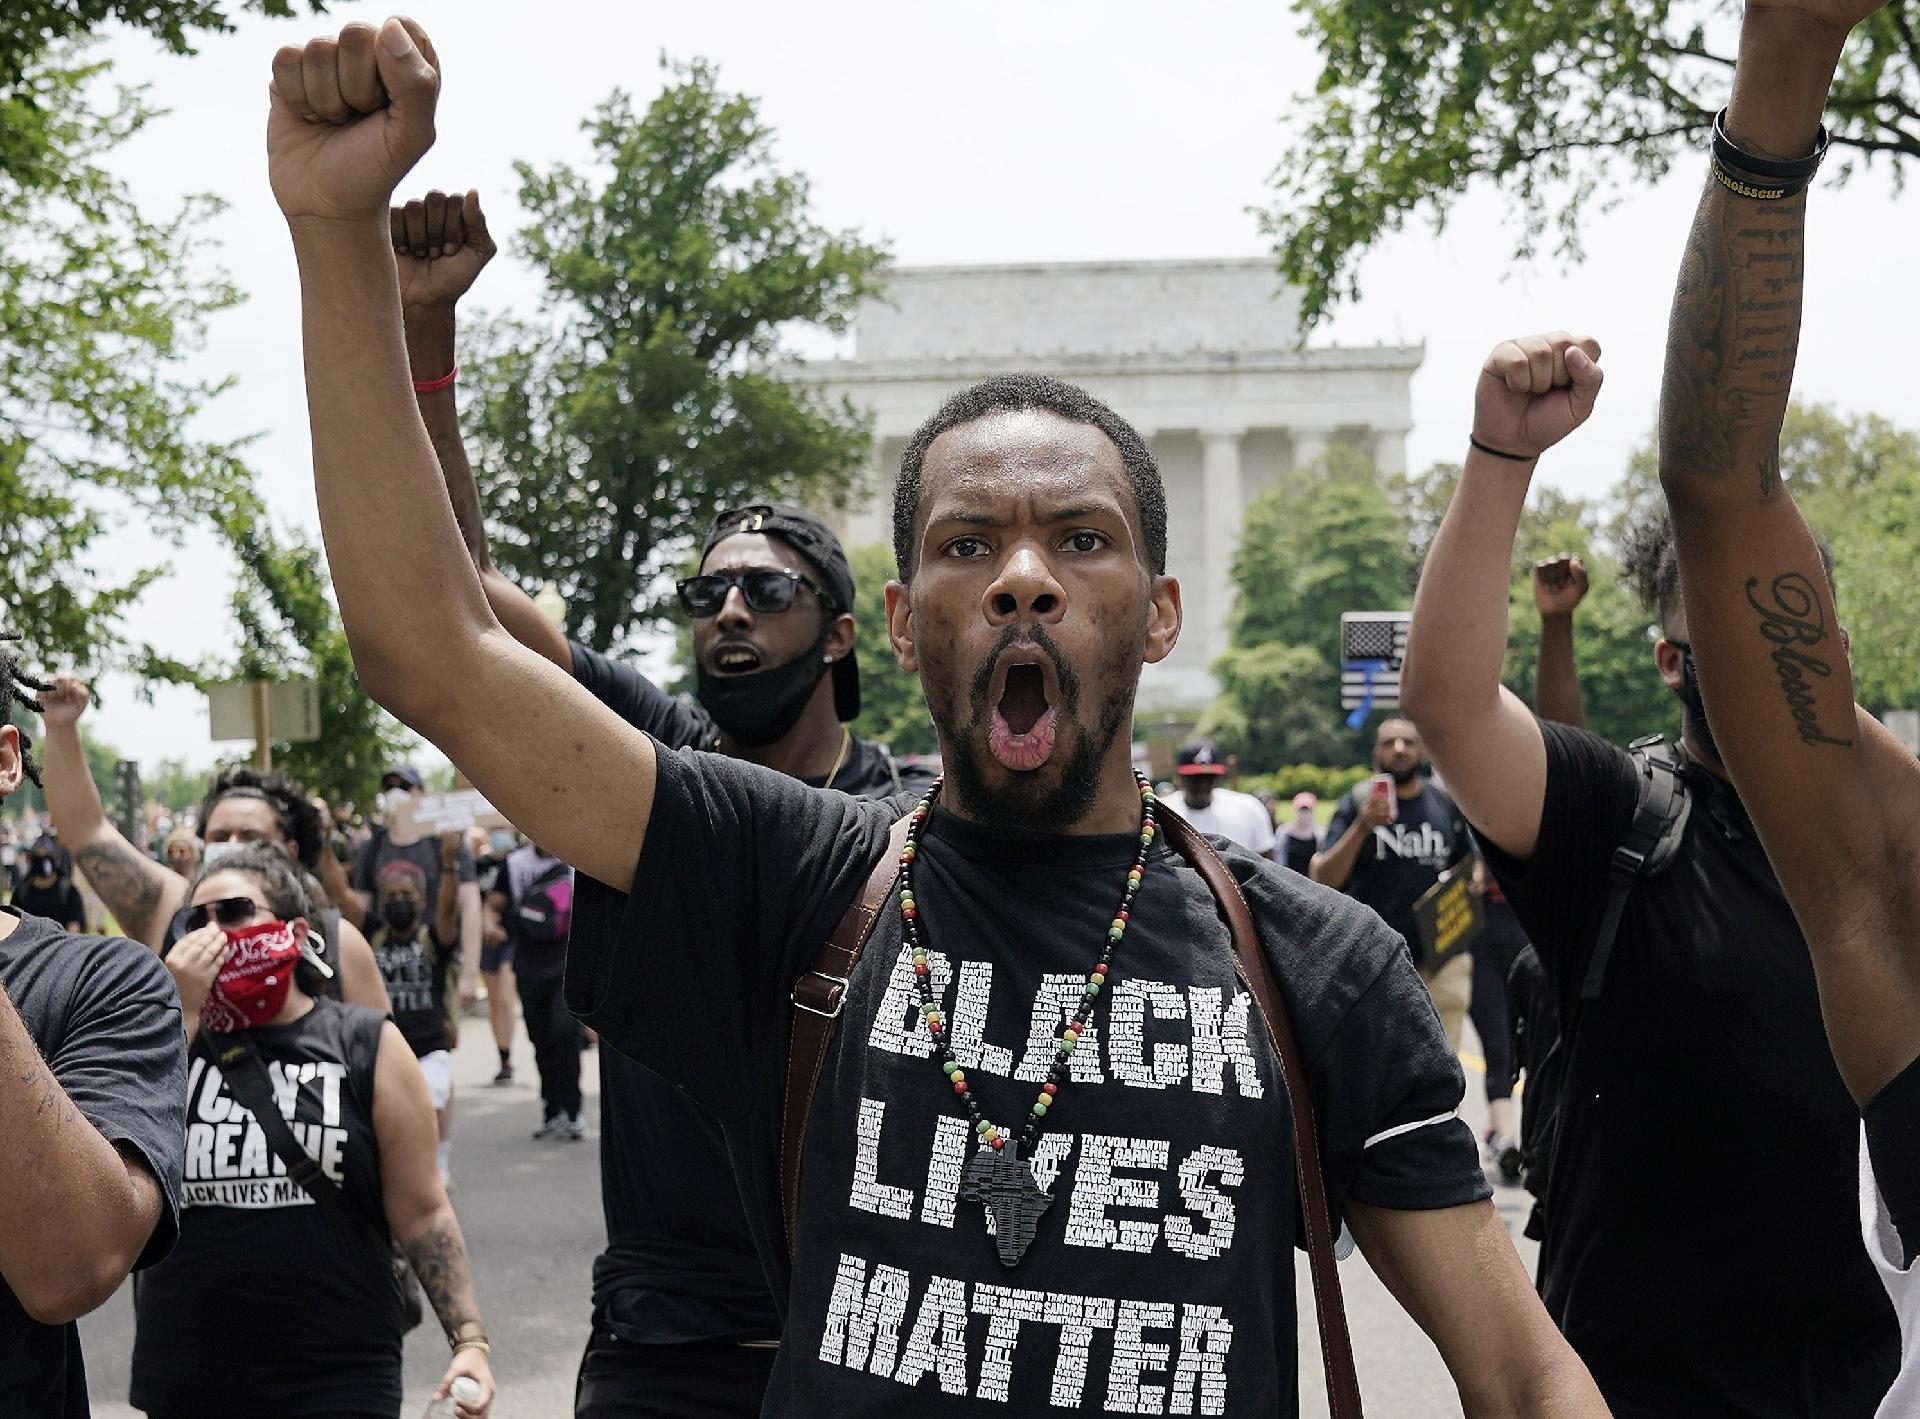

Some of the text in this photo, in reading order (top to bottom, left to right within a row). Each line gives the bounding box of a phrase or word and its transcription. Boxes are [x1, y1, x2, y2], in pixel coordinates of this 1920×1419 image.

[1744, 572, 1853, 746] Blessed
[959, 974, 992, 990] ERIC
[1043, 974, 1086, 984] TRAYVON
[1041, 983, 1087, 994] MARTIN
[1109, 1012, 1143, 1022] TAMIR
[1112, 1003, 1187, 1020] DIALLO GRAY
[866, 942, 1264, 1100] BLACK
[1031, 1020, 1059, 1031] GRAY
[1109, 1022, 1143, 1035] RICE
[1192, 1024, 1222, 1039] TILL
[1154, 1043, 1188, 1055] OSCAR
[1154, 1052, 1188, 1062] GRANT
[1014, 1069, 1104, 1084] DAVIS BLAND
[1109, 1061, 1189, 1077] JONATHAN ERIC
[1114, 1070, 1154, 1082] FERRELL
[1240, 1084, 1265, 1100] GRAY
[1081, 1134, 1170, 1152] TRAYVON MARTIN
[184, 1121, 349, 1182] REAE
[1080, 1145, 1169, 1165] ERIC GARNER
[1075, 1171, 1110, 1185] DAVIS
[1220, 1173, 1244, 1186] GRAY
[183, 1184, 217, 1202] ACK
[222, 1182, 268, 1203] LIVES
[1071, 1191, 1114, 1205] RENISHA
[1074, 1182, 1159, 1199] AMADOU DIALLO
[923, 1196, 958, 1213] GRAY
[1068, 1215, 1159, 1233] MICHAEL BROWN
[1065, 1224, 1158, 1247] KIMANI GRAY
[975, 1282, 1044, 1302] TRAYVON MARTIN
[1046, 1291, 1115, 1308] TRAYVON MARTIN
[973, 1292, 1043, 1313] ERIC GARNER
[1043, 1302, 1115, 1320] SANDRA BLAND
[1139, 1309, 1174, 1321] GARNER
[819, 1252, 1233, 1416] MATTER
[1060, 1332, 1093, 1347] GRAY
[985, 1345, 1012, 1365] TILL
[1207, 1340, 1232, 1354] GRAY
[1057, 1354, 1089, 1373] RICE
[976, 1386, 1008, 1402] DAVIS
[1051, 1383, 1083, 1399] ERIC
[1107, 1390, 1164, 1405] TAMIR RICE
[1103, 1400, 1164, 1415] SANDRA BLAND
[1171, 1392, 1194, 1407] ERIC
